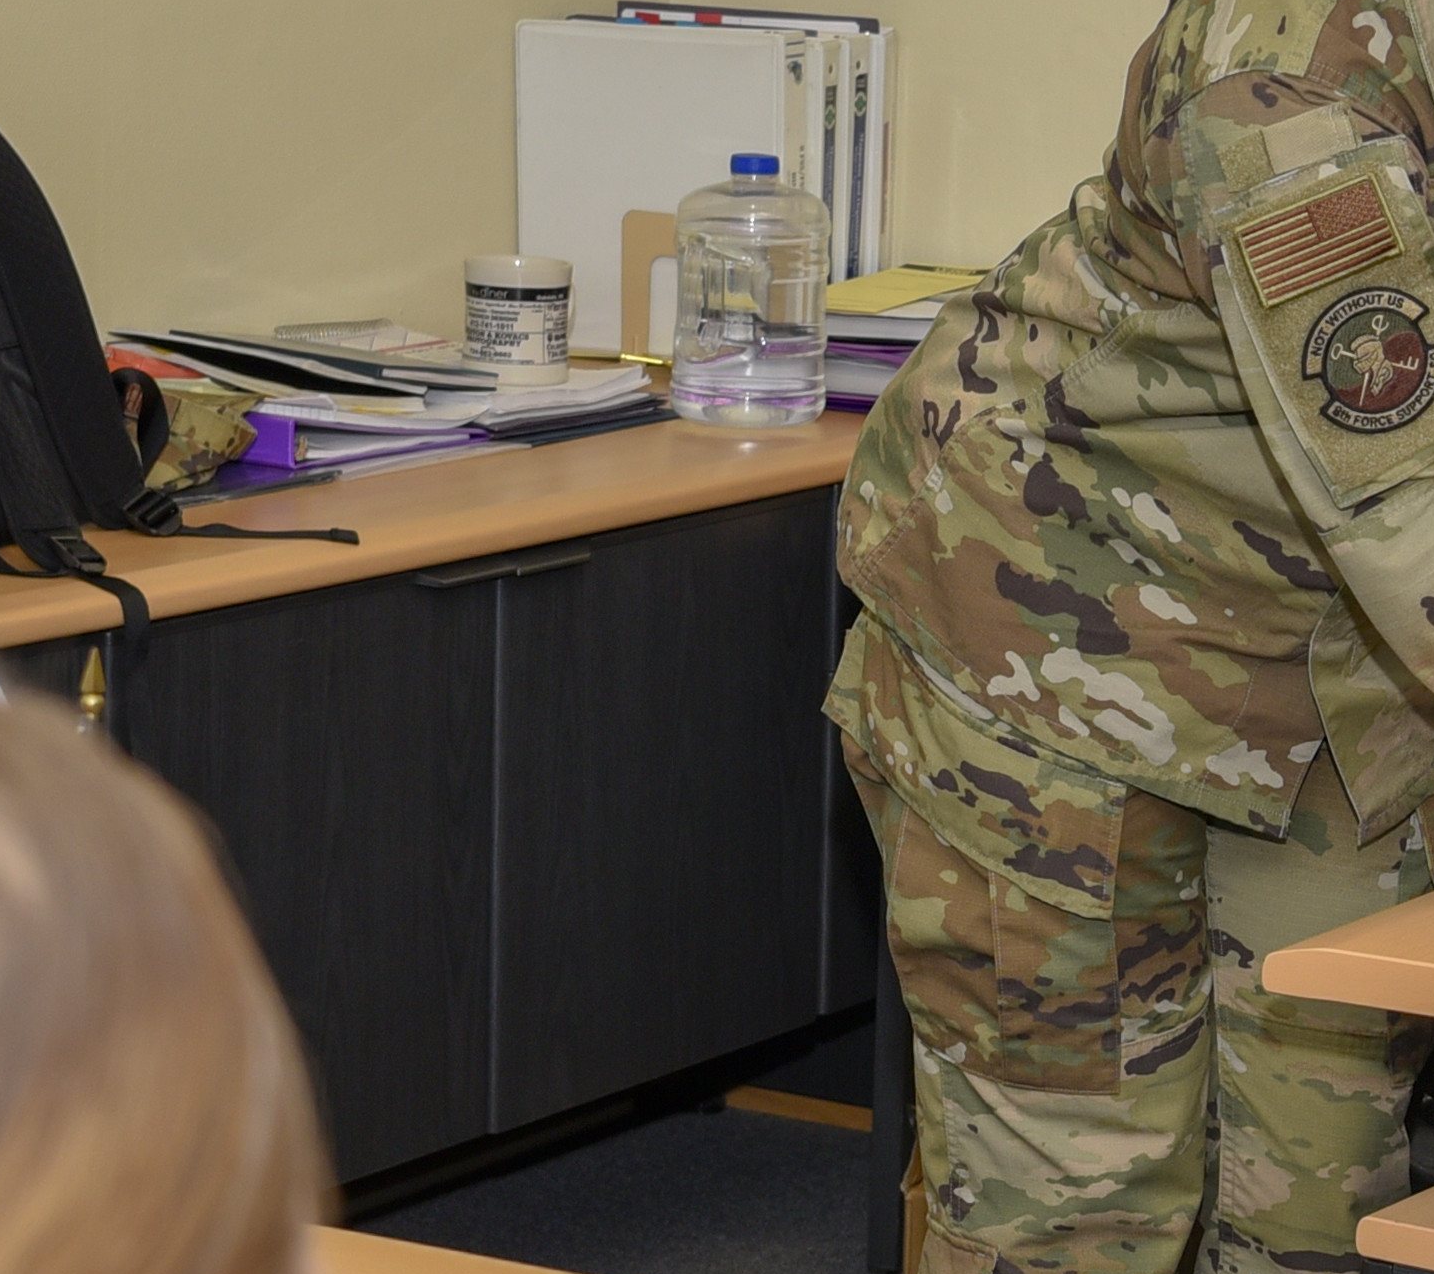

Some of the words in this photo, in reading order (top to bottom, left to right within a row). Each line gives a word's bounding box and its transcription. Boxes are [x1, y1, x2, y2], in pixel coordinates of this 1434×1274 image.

[1310, 327, 1329, 356] NOT
[1325, 294, 1384, 327] WITHOUT
[1387, 295, 1405, 309] US
[1332, 405, 1351, 422] 8th
[1353, 415, 1395, 427] FORCE
